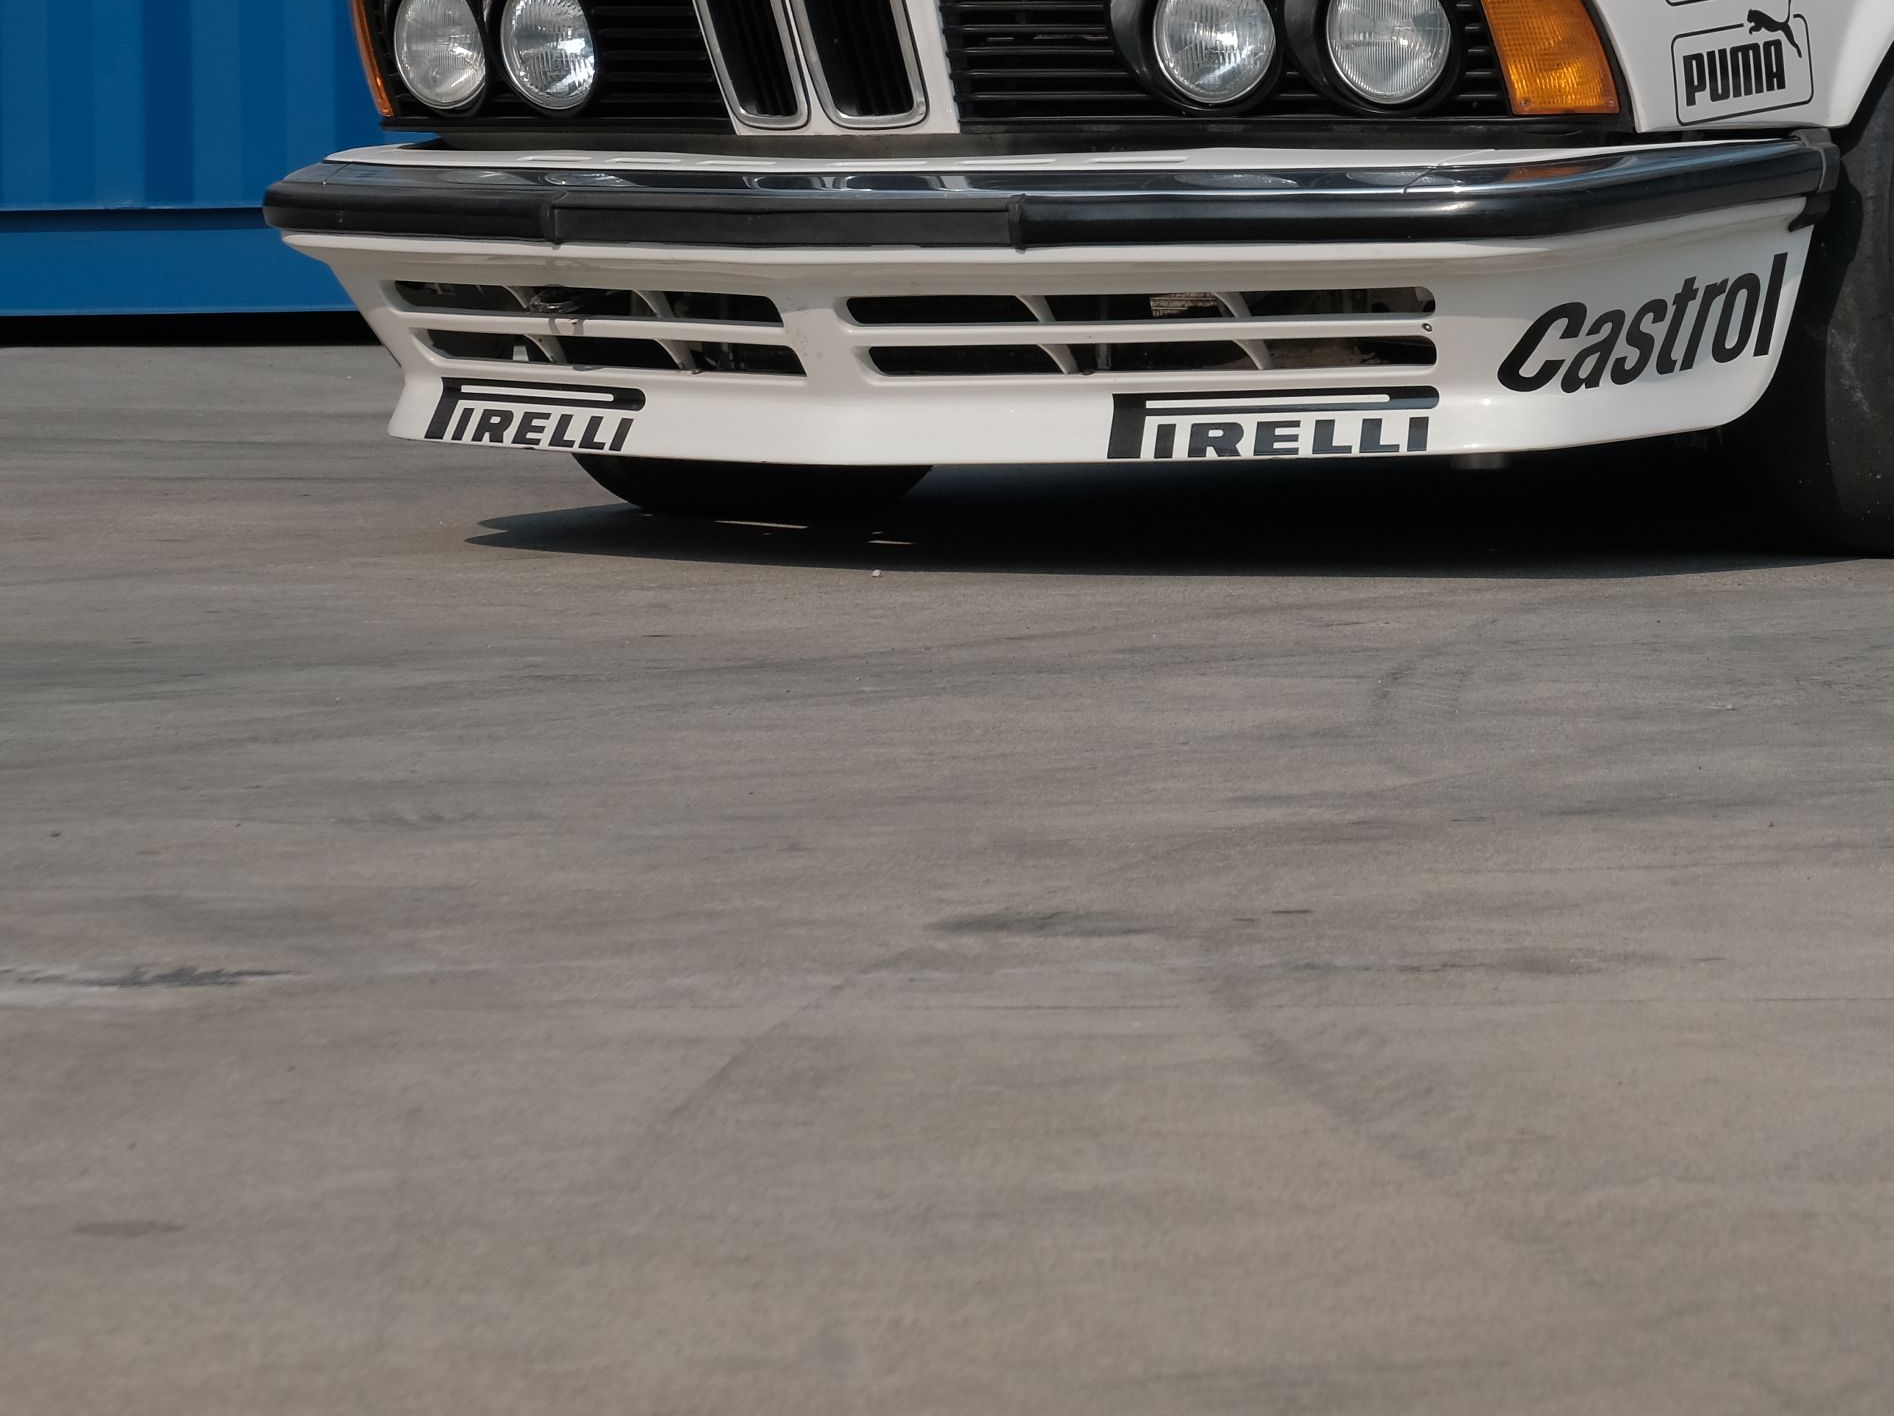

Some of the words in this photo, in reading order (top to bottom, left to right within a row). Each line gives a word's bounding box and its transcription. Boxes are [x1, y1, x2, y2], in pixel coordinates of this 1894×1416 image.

[1682, 38, 1787, 107] PUMA
[1498, 252, 1789, 394] Castrol
[423, 376, 647, 452] PIRELLI
[1106, 385, 1440, 460] PIRELLI
